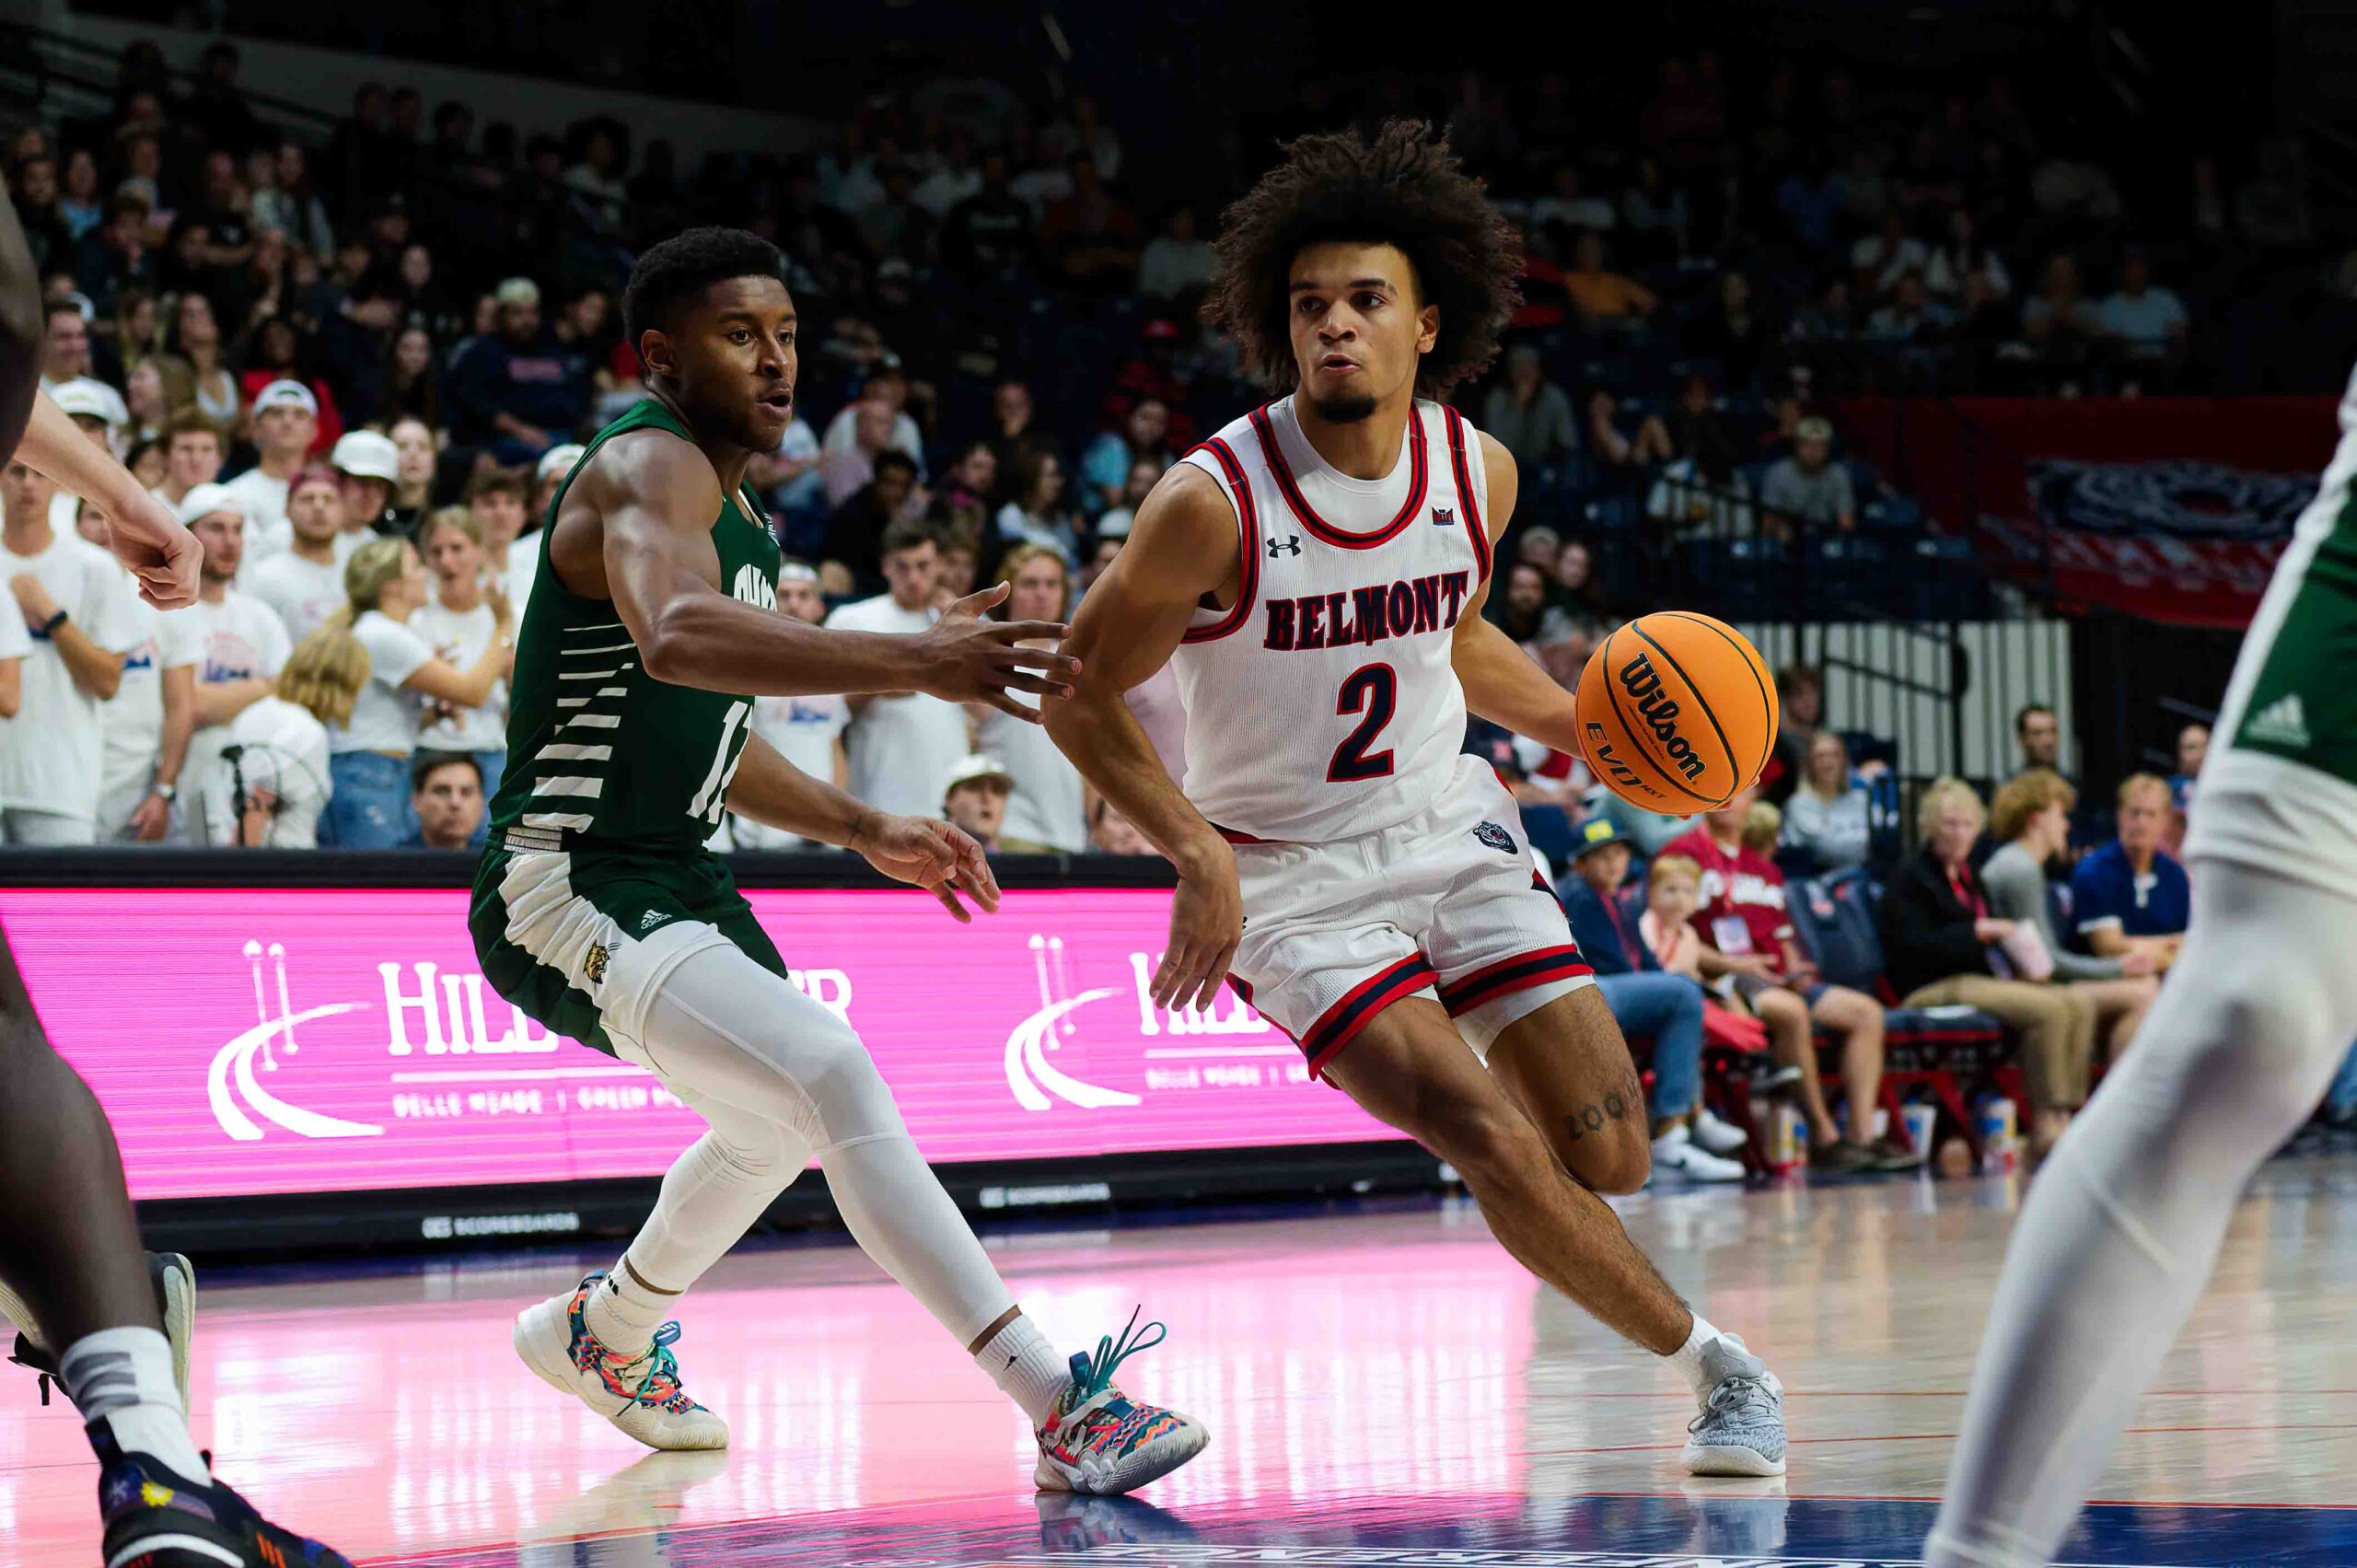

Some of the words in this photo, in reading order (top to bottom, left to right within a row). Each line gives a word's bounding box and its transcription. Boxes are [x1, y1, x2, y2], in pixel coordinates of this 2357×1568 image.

[1263, 570, 1469, 651] BELMONT
[1326, 662, 1397, 783] 2
[1620, 651, 1707, 782] Wilson
